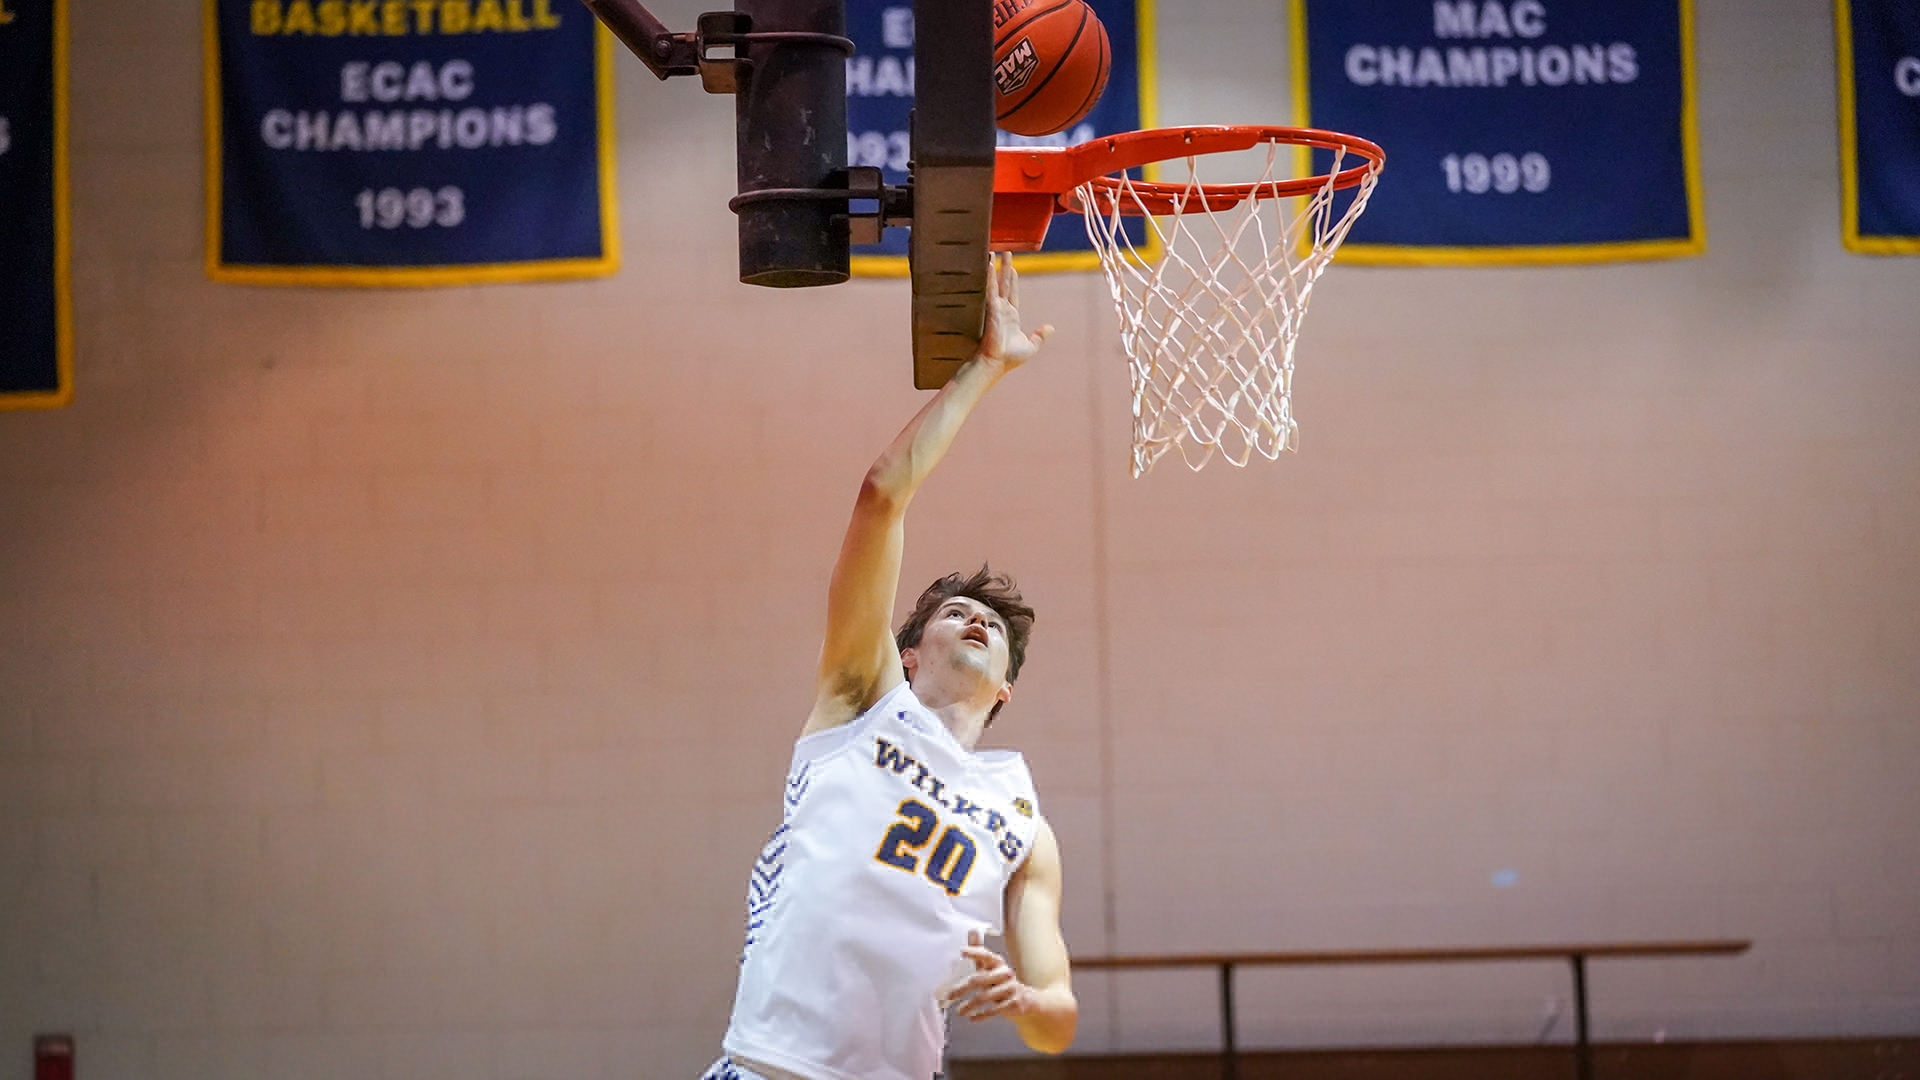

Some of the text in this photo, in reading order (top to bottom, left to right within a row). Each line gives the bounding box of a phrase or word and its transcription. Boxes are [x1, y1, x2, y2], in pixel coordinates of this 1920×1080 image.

[250, 0, 561, 35] BASKETBALL
[1434, 0, 1546, 38] MAC
[340, 60, 474, 101] ECAC
[994, 40, 1032, 84] MAC
[1345, 42, 1639, 86] CHAMPIONS
[261, 104, 557, 150] CHAMPIONS
[1441, 152, 1551, 193] 1999
[355, 186, 466, 229] 1993
[873, 797, 978, 896] 20
